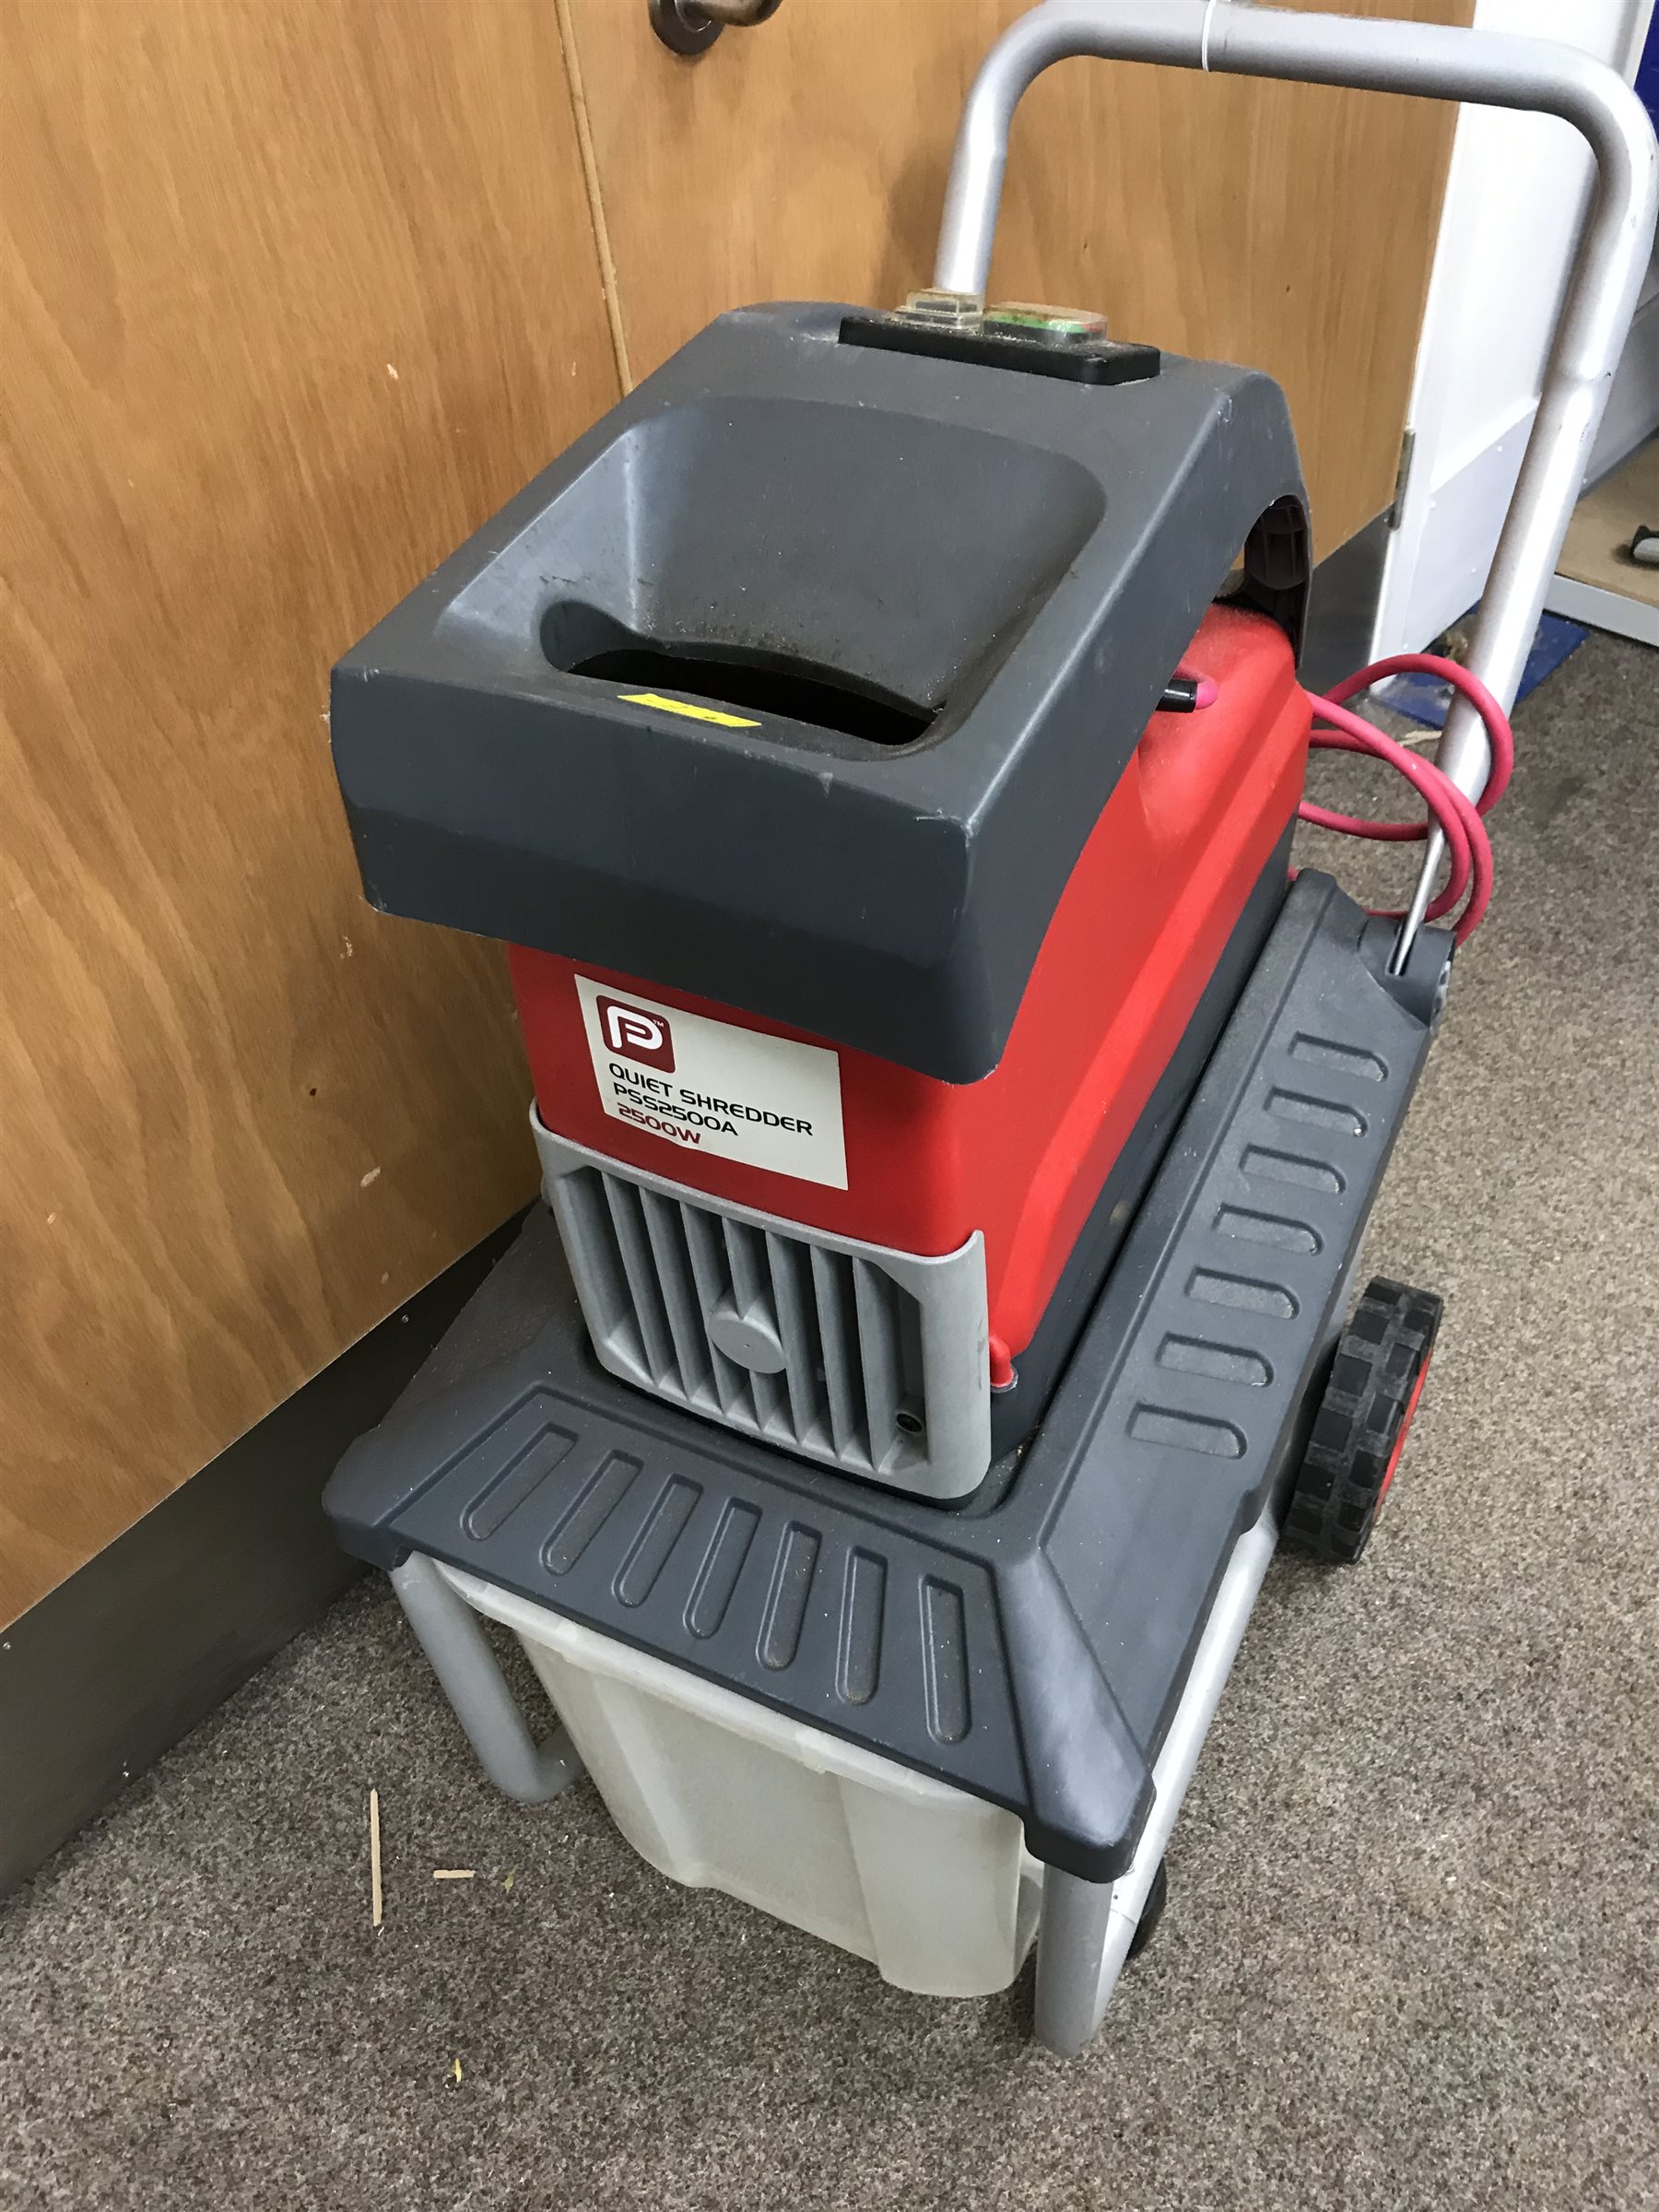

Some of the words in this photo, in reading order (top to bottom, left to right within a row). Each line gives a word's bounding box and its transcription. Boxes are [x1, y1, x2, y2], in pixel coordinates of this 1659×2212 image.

[609, 1063, 673, 1097] QUIET
[679, 1088, 813, 1135] SHREDDER
[613, 1082, 738, 1135] PSS2500A
[617, 1101, 700, 1144] 2500W
